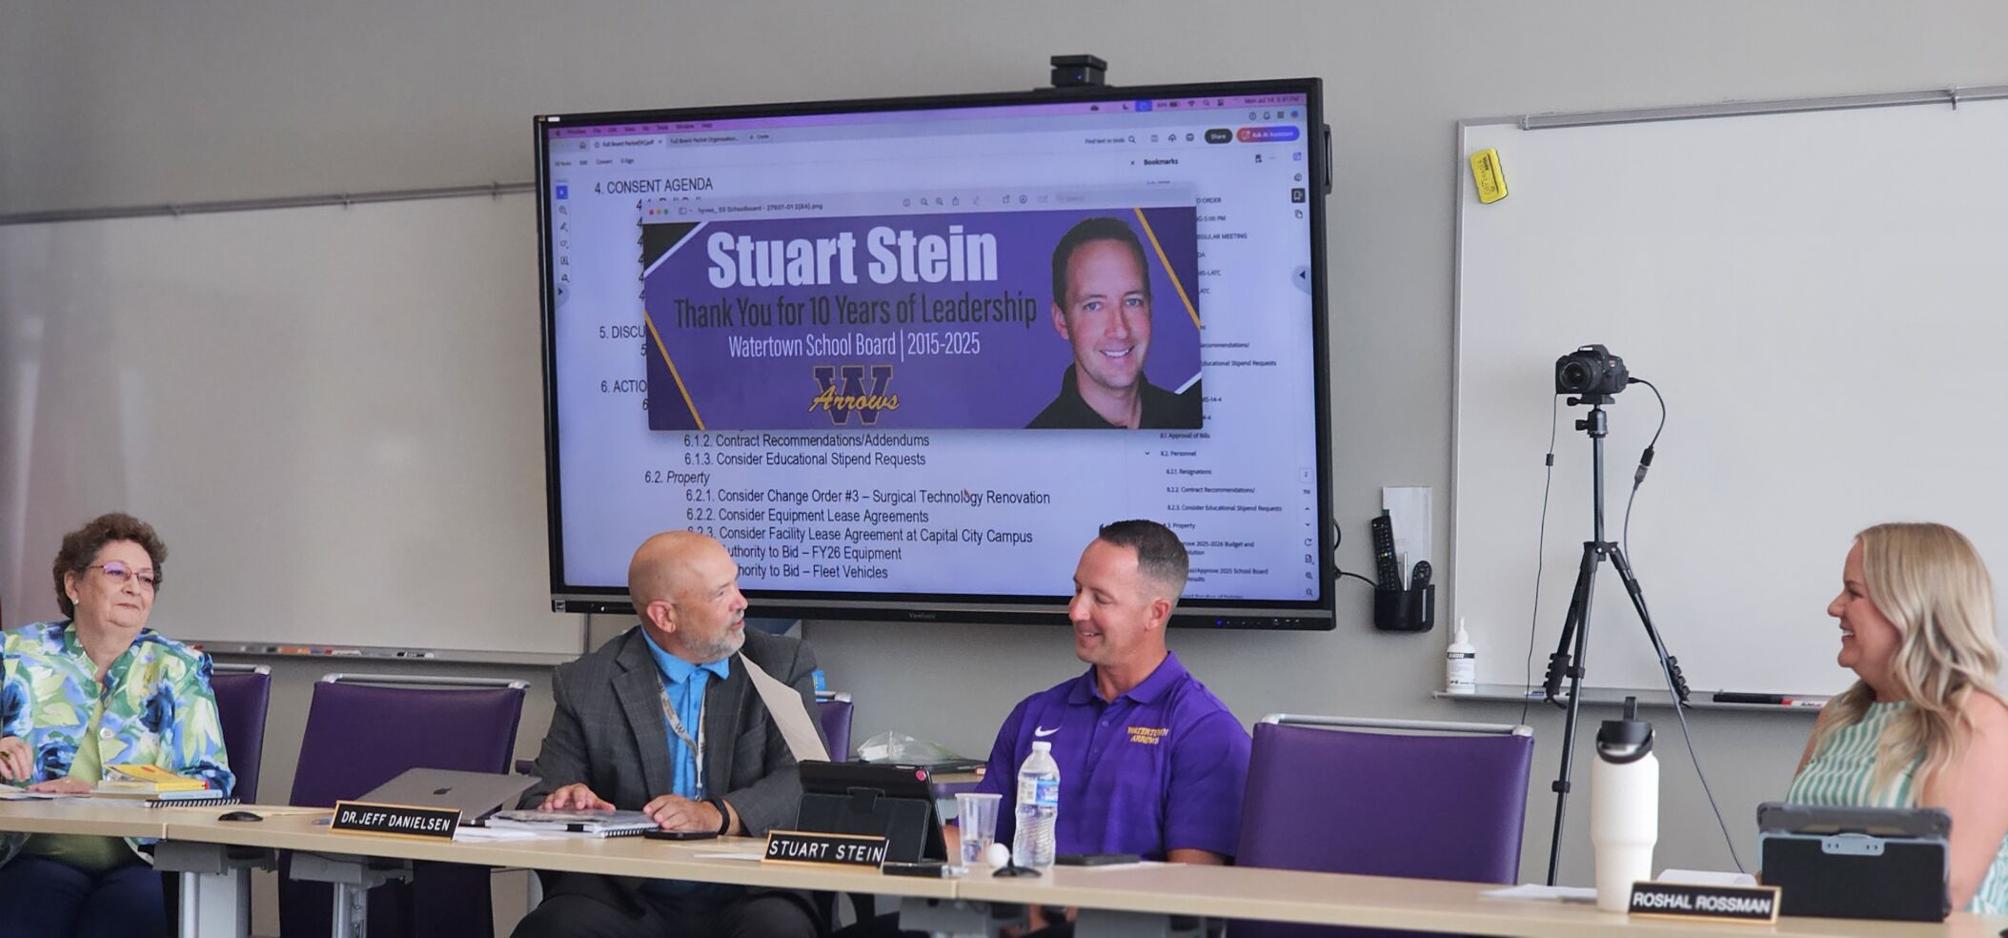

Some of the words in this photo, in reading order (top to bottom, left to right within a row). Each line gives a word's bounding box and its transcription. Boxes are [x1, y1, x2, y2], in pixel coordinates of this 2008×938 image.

[1144, 158, 1178, 166] Bookmarks
[607, 179, 661, 194] CONSENT
[664, 177, 713, 192] AGENDA
[707, 231, 857, 288] Stuart
[867, 225, 998, 283] Stein
[674, 298, 733, 329] Thank
[734, 297, 772, 327] You
[777, 296, 805, 326] for
[810, 296, 830, 325] 10
[835, 294, 891, 325] Years
[897, 293, 917, 323] of
[922, 291, 1037, 329] Leadership
[612, 325, 645, 339] DISCU
[728, 335, 803, 358] Watertown
[806, 333, 852, 356] School
[856, 331, 896, 355] Board
[908, 331, 981, 355] 2015-2025
[613, 379, 647, 393] ACTIO
[813, 365, 893, 425] W
[809, 384, 901, 412] Arrows
[684, 434, 713, 448] 6.1.2.
[715, 433, 760, 447] Contract
[763, 433, 930, 448] Recommendations/Addendums
[685, 453, 714, 466] 6.1.3.
[716, 452, 762, 466] Consider
[766, 452, 828, 466] Educational
[831, 452, 872, 468] Stipend
[875, 453, 926, 468] Requests
[645, 471, 664, 484] 6.2.
[667, 471, 710, 487] Property
[686, 489, 715, 502] 6.2.1.
[718, 489, 764, 502] Consider
[768, 489, 809, 506] Change
[812, 489, 842, 502] Order
[845, 489, 860, 502] #3
[872, 490, 917, 506] Surgical
[920, 489, 983, 507] Technology
[986, 490, 1050, 504] Renovation
[686, 508, 716, 521] 6.2.2.
[719, 508, 765, 521] Consider
[768, 509, 824, 525] Equipment
[827, 509, 860, 522] Lease
[863, 509, 929, 526] Agreements
[720, 527, 766, 540] Consider
[769, 526, 805, 543] Facility
[808, 528, 841, 541] Lease
[844, 528, 903, 545] Agreement
[906, 530, 918, 542] at
[920, 528, 958, 546] Capital
[961, 529, 983, 546] City
[986, 529, 1033, 546] Campus
[729, 545, 765, 562] uthority
[769, 547, 779, 558] to
[783, 545, 799, 558] Bid
[812, 546, 841, 559] FY26
[844, 547, 902, 563] Equipment
[738, 564, 767, 580] hority
[770, 566, 780, 578] to
[783, 564, 800, 578] Bid
[813, 565, 840, 578] Fleet
[842, 565, 888, 579] Vehicles
[1127, 726, 1169, 737] WATERTOWN
[389, 815, 450, 831] DANIELSEN
[769, 839, 830, 858] STUART
[835, 843, 883, 863] STEIN
[1633, 893, 1691, 909] ROSHAL
[1696, 896, 1771, 913] ROSSMAN
